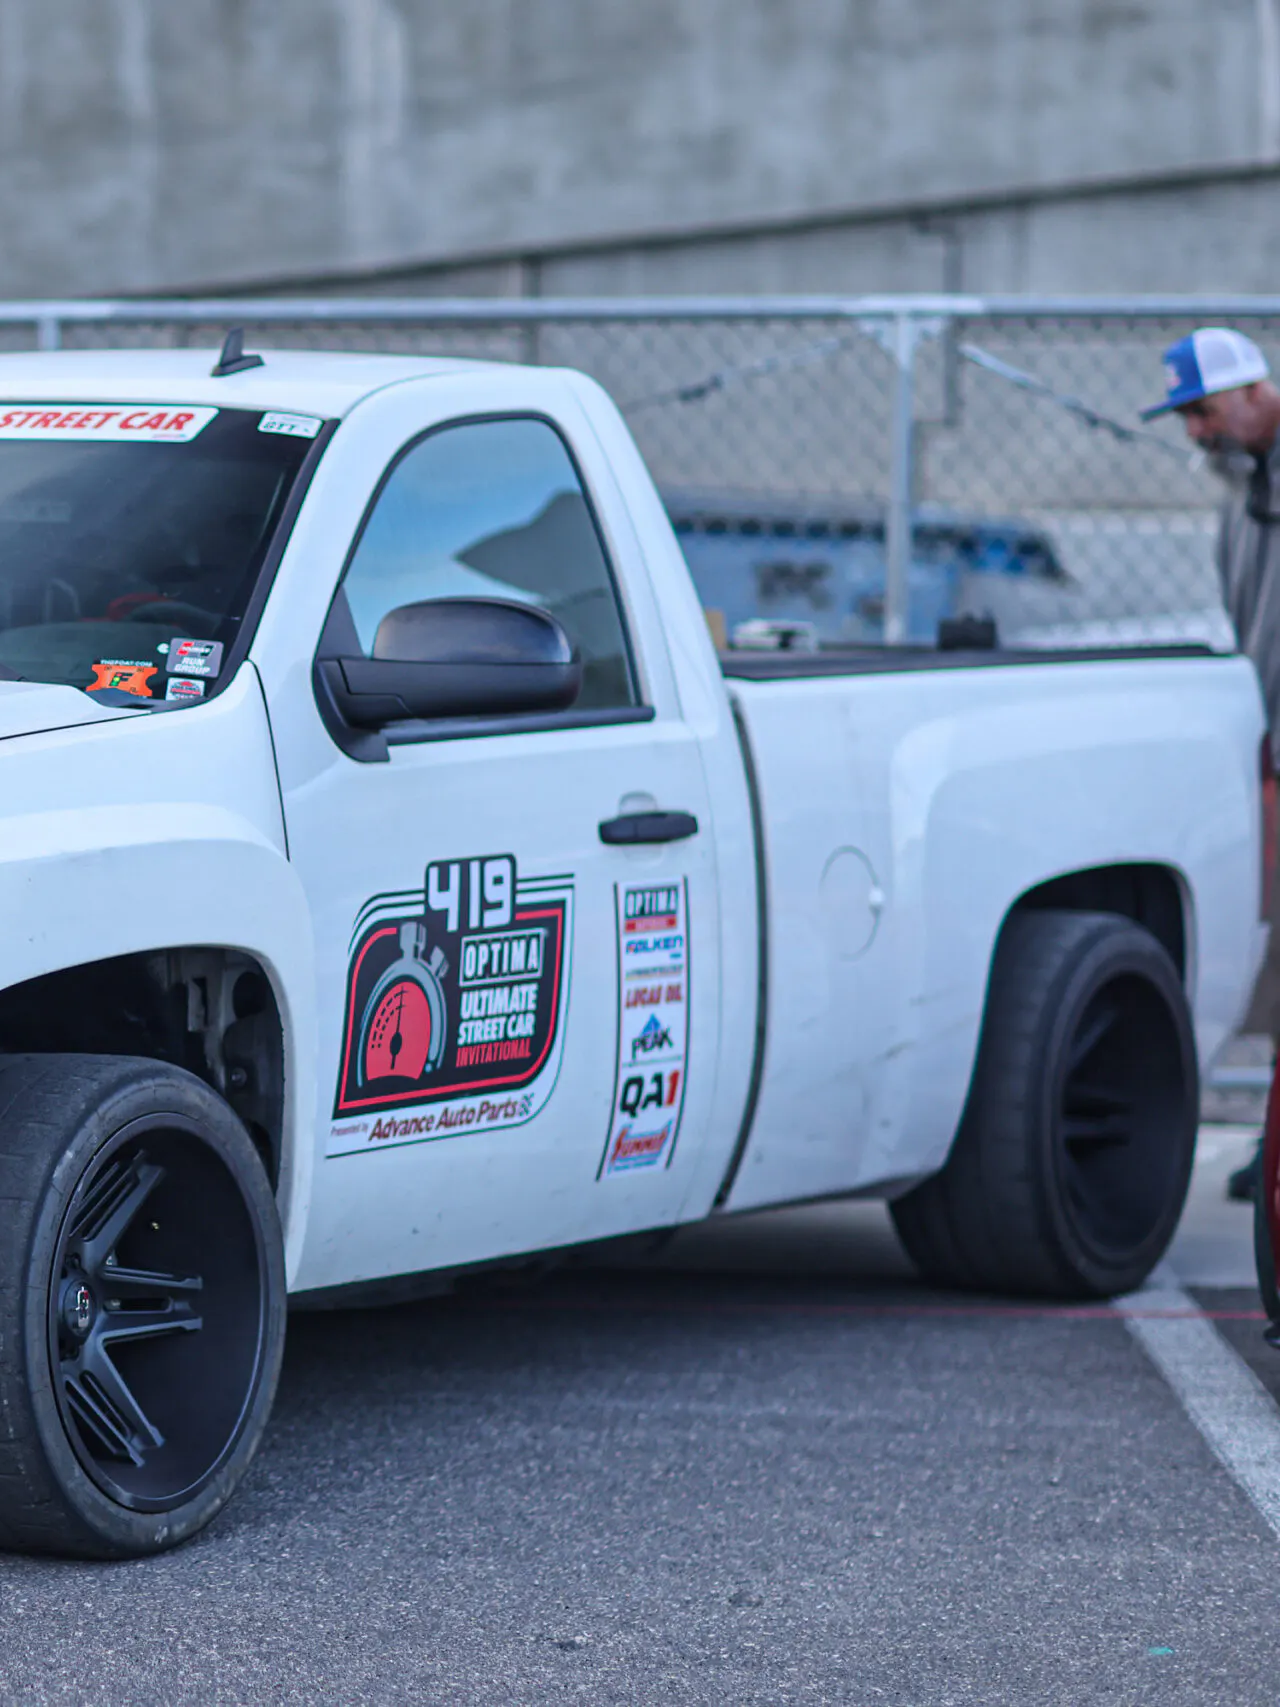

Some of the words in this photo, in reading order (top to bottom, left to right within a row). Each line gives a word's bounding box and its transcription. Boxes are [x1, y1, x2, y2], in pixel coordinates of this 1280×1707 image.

[120, 412, 195, 430] CAR
[428, 857, 512, 932] 419
[627, 889, 677, 916] OPTIMA
[464, 936, 540, 979] OPTIMA
[625, 935, 683, 954] FALKEN
[460, 982, 538, 1020] ULTIMATE
[625, 985, 662, 1008] LUCAS
[457, 1015, 505, 1046] STREET
[506, 1012, 536, 1039] CAR
[631, 1028, 674, 1060] PEAK
[455, 1042, 531, 1068] INVITATIONAL
[620, 1070, 680, 1118] QA1
[368, 1116, 434, 1141] Advance
[436, 1105, 473, 1129] Auto
[476, 1098, 518, 1125] Parts
